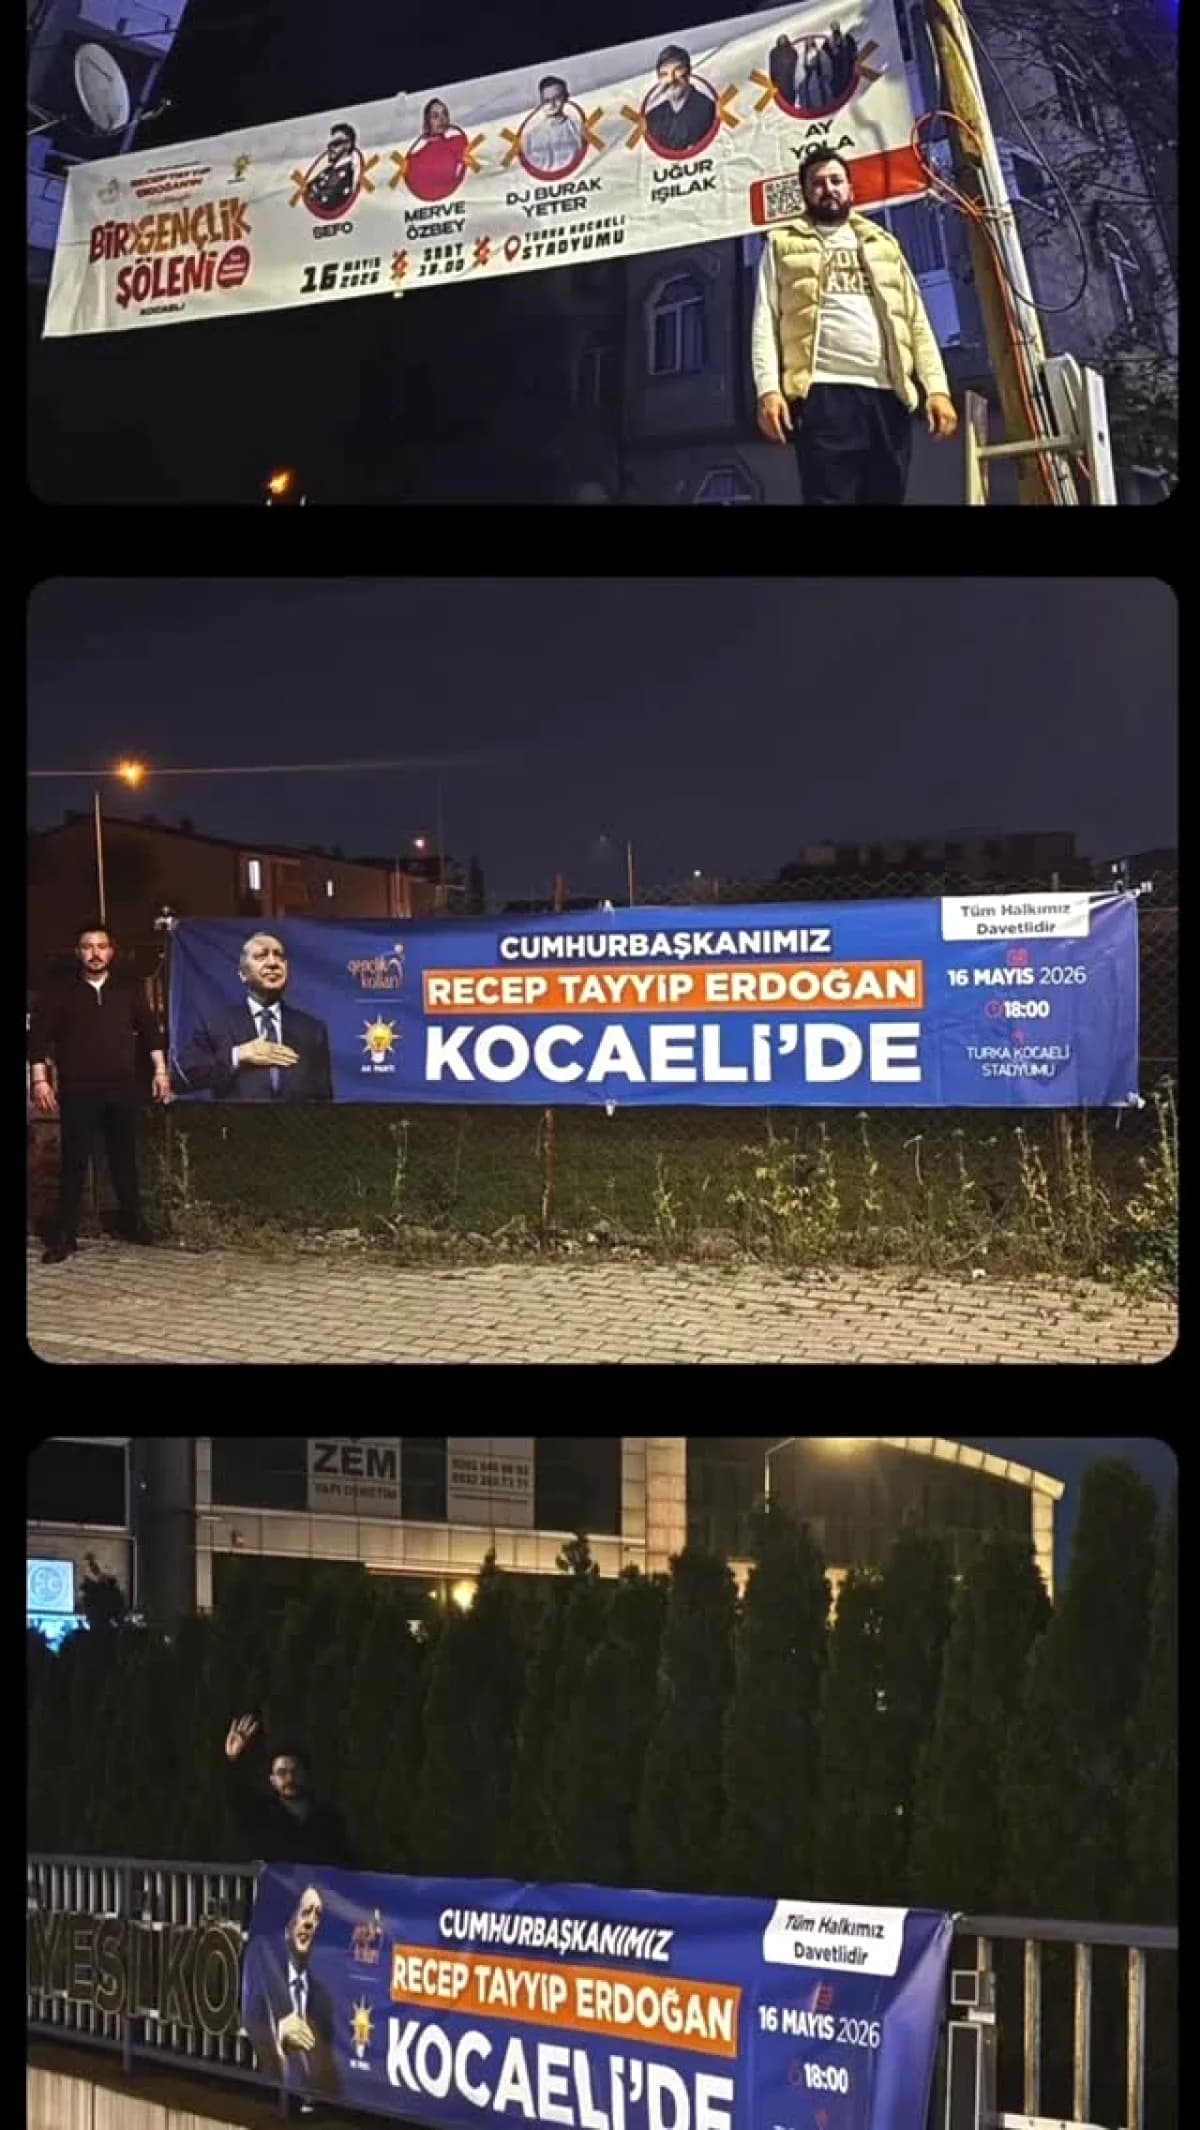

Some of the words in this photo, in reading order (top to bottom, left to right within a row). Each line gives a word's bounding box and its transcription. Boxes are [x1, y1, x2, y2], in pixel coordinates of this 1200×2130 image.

[806, 120, 833, 138] AY
[653, 158, 714, 183] UĞUR
[506, 190, 530, 206] DJ
[534, 177, 602, 200] BURAK
[651, 176, 717, 203] IŞILAK
[404, 200, 466, 223] MERVE
[523, 196, 587, 218] YETER
[90, 220, 130, 264] BİR
[136, 197, 251, 254] GENÇLİK
[312, 222, 353, 240] SEFO
[406, 219, 466, 241] ÖZBEY
[522, 229, 625, 260] STADYUMU
[116, 250, 218, 310] ŞÖLENİ
[300, 263, 339, 293] 16
[960, 904, 996, 918] Tüm
[1000, 903, 1072, 917] Halkımız
[976, 921, 1056, 936] Davetlidir
[500, 928, 831, 961] CUMHURBAŞKANIMIZ
[426, 975, 547, 1006] RECEP
[558, 973, 693, 1005] TAYYİP
[705, 967, 917, 1003] ERDOĞAN
[947, 968, 968, 986] 16
[973, 967, 1035, 985] MAYIS
[1039, 966, 1087, 985] 2026
[1003, 1000, 1050, 1019] 18:00
[966, 1046, 1011, 1060] TURKA
[981, 1062, 1055, 1077] STADYUMU
[313, 1443, 396, 1480] ZEM
[440, 1908, 674, 1962] CUMHURBAŞKANIMIZ
[785, 1914, 815, 1932] Tüm
[818, 1915, 885, 1940] Halkımız
[794, 1941, 868, 1966] Davetlidir
[392, 1954, 469, 1999] RECEP
[474, 1963, 568, 2014] TAYYİP
[576, 1977, 735, 2043] ERDOĞAN
[758, 2005, 778, 2032] 16
[781, 2008, 835, 2041] MAYIS
[836, 2016, 881, 2049] 2026
[803, 2062, 849, 2095] 18:00
